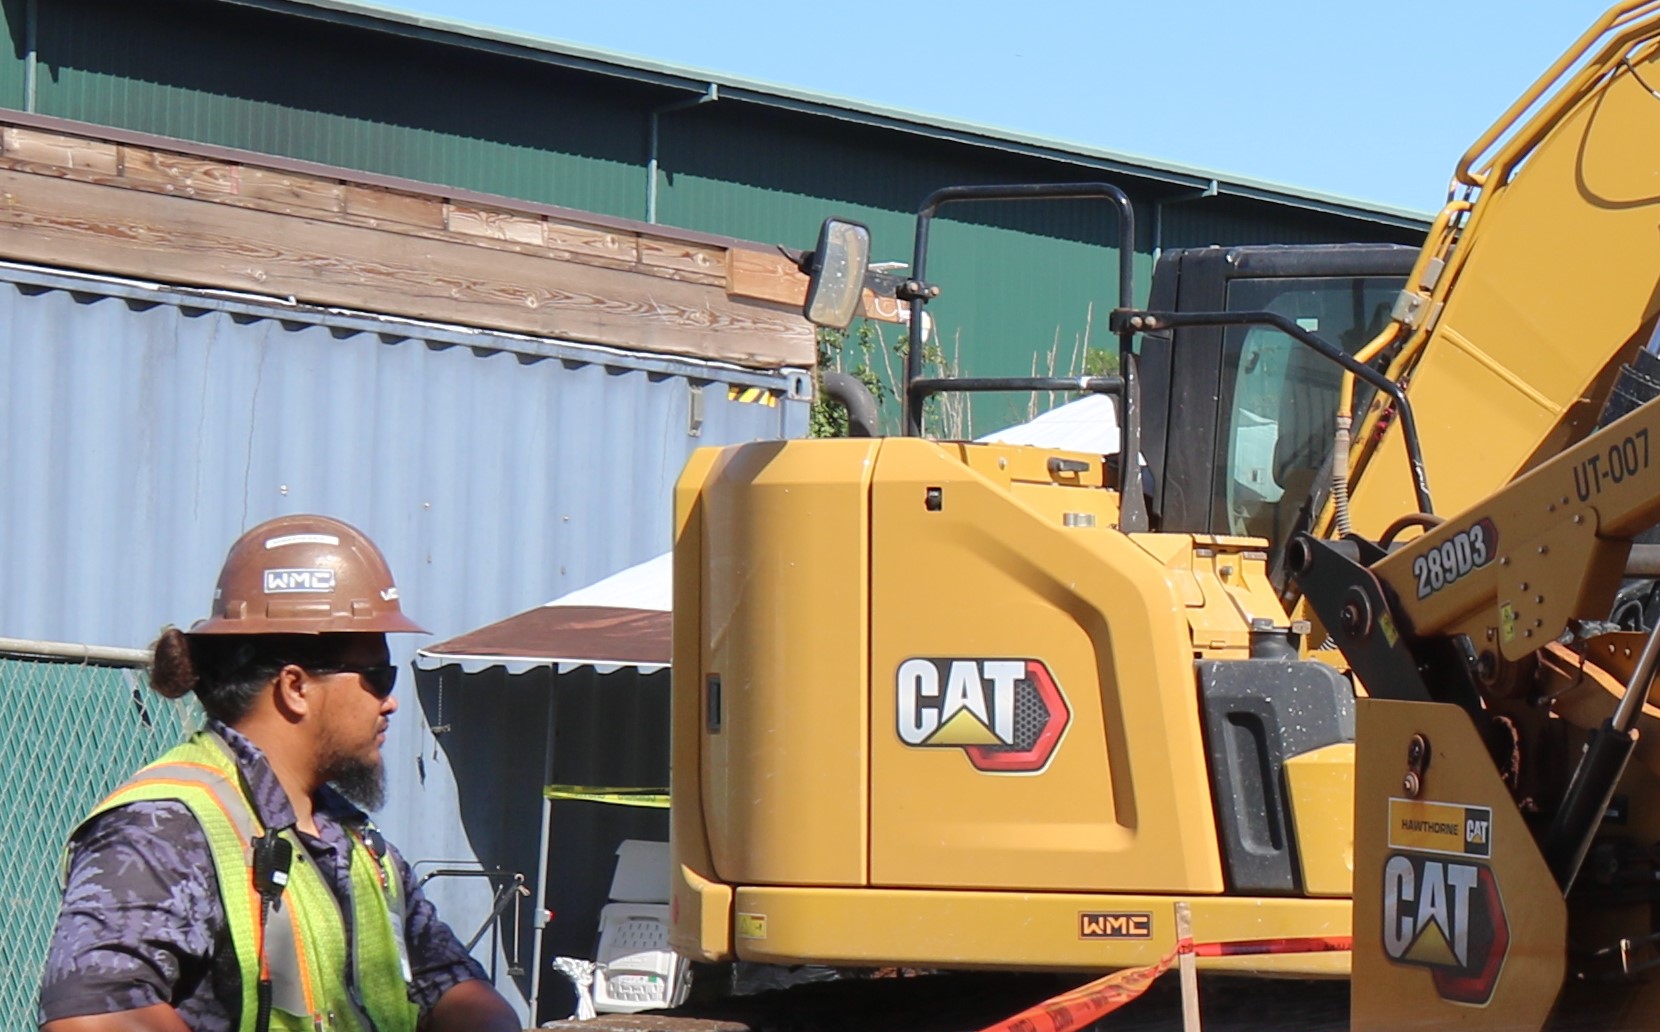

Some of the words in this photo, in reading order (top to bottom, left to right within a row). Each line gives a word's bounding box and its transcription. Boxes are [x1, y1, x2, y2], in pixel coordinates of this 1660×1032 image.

[1573, 428, 1650, 503] UT-007
[268, 572, 331, 589] WMC
[1413, 523, 1488, 600] 289D3
[897, 658, 1027, 745] CAT
[1401, 819, 1459, 837] HAWTHORNE
[1466, 819, 1489, 844] CAT
[1083, 916, 1149, 935] WMC
[1384, 855, 1479, 969] CAT
